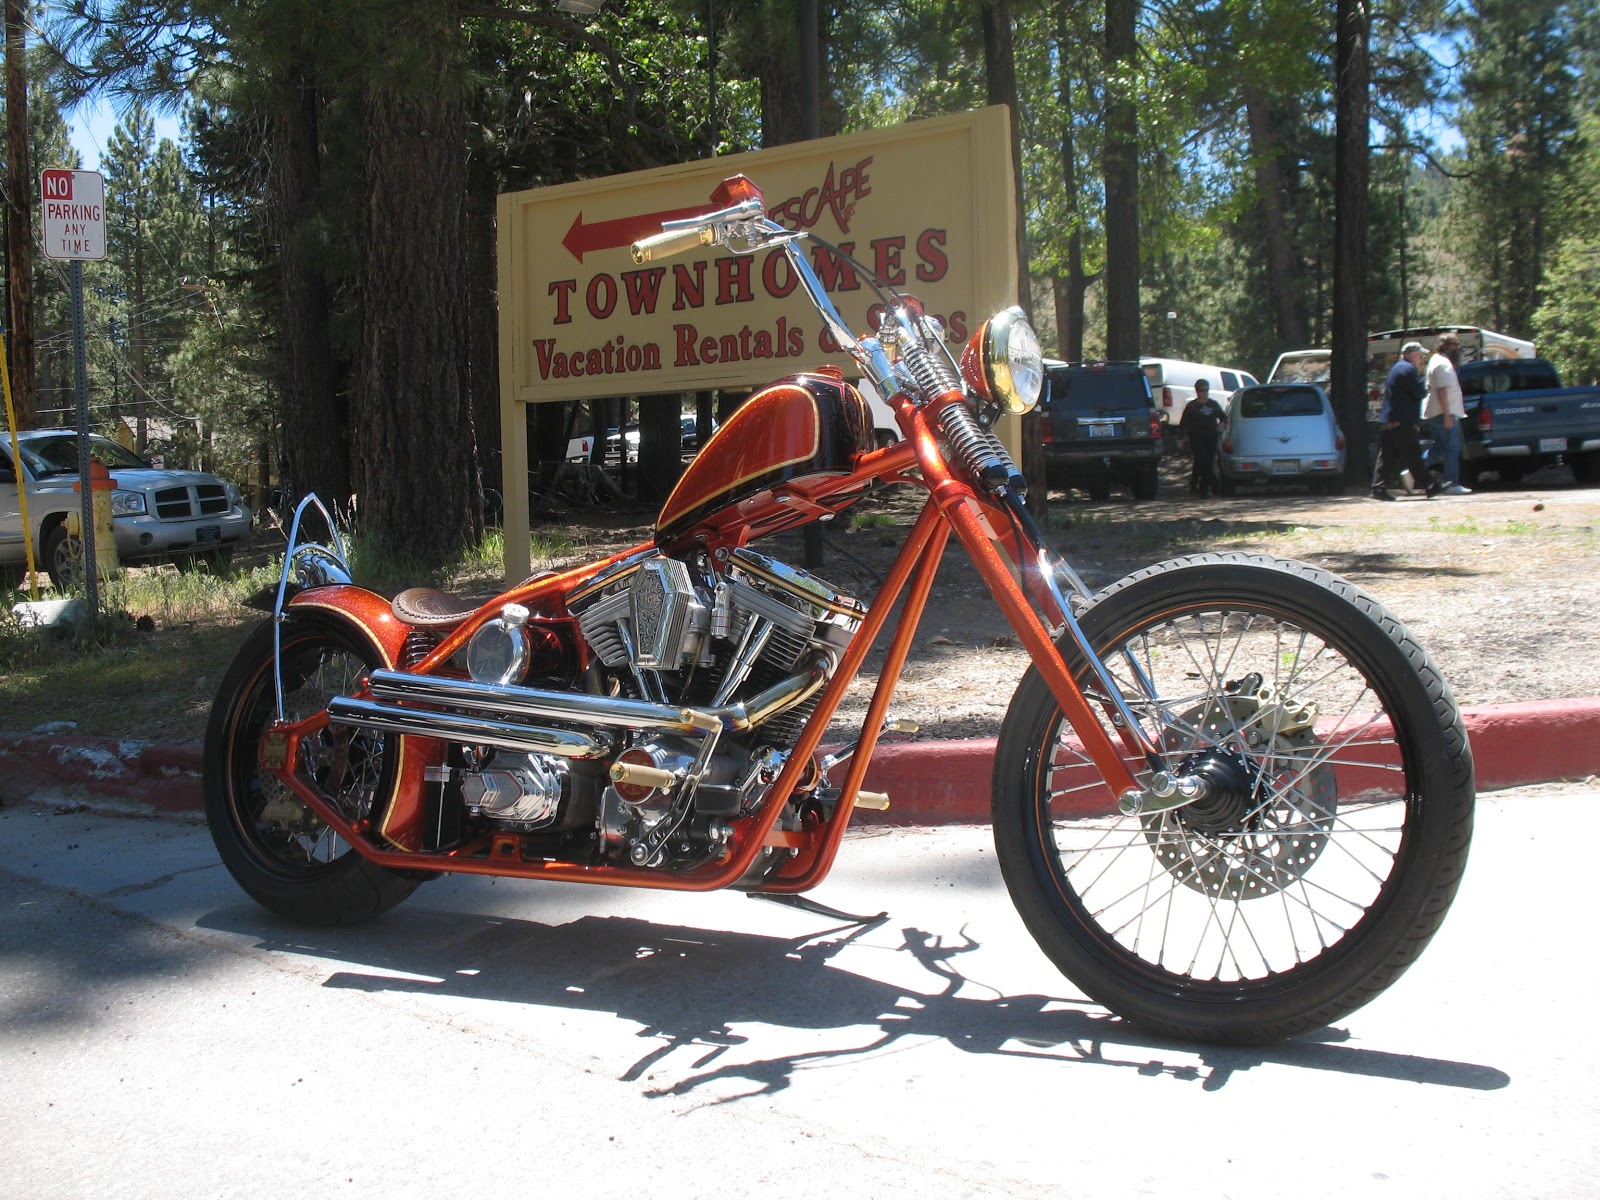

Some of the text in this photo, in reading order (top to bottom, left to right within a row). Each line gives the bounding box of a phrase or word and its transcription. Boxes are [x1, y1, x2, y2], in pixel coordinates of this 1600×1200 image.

[46, 176, 68, 197] NO
[48, 203, 100, 222] PARKING
[64, 223, 86, 236] ANY
[61, 239, 90, 252] TIME
[548, 228, 949, 325] TOWNHOMES
[533, 335, 661, 380] Vacation
[673, 316, 804, 367] Rentals
[1495, 406, 1535, 415] DODGE
